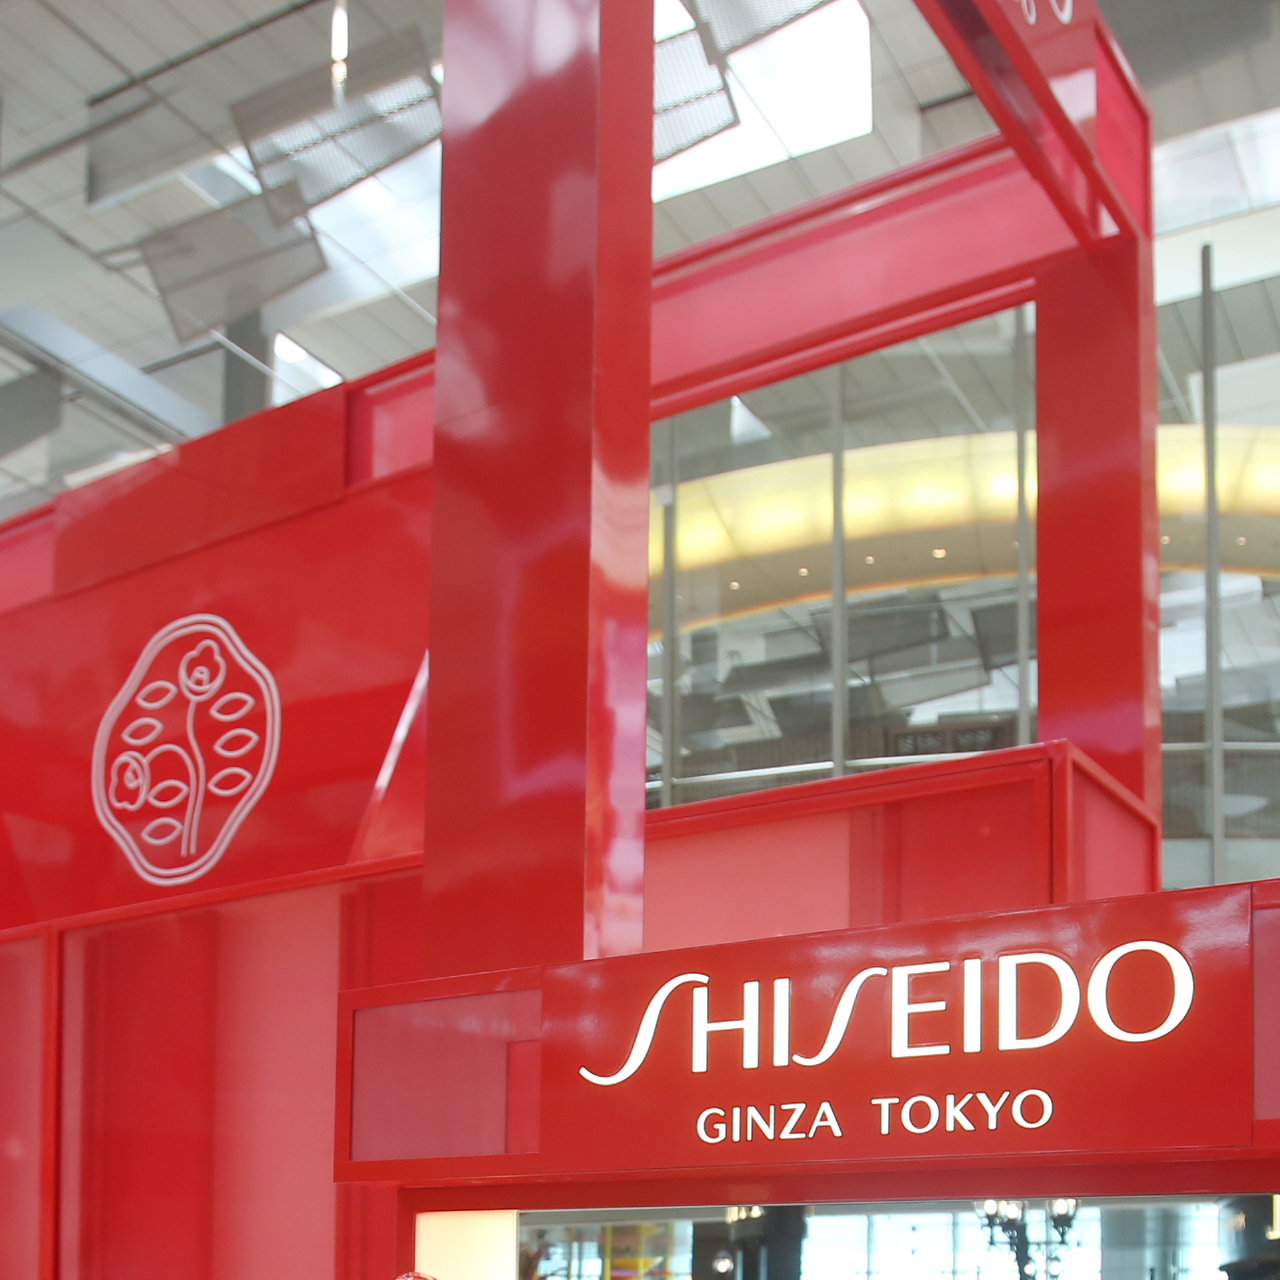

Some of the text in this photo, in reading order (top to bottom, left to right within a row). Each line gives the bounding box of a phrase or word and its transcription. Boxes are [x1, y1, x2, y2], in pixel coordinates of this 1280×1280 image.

[578, 939, 1195, 1087] SHISEIDO
[696, 1088, 1054, 1144] GINZA TOKYO
